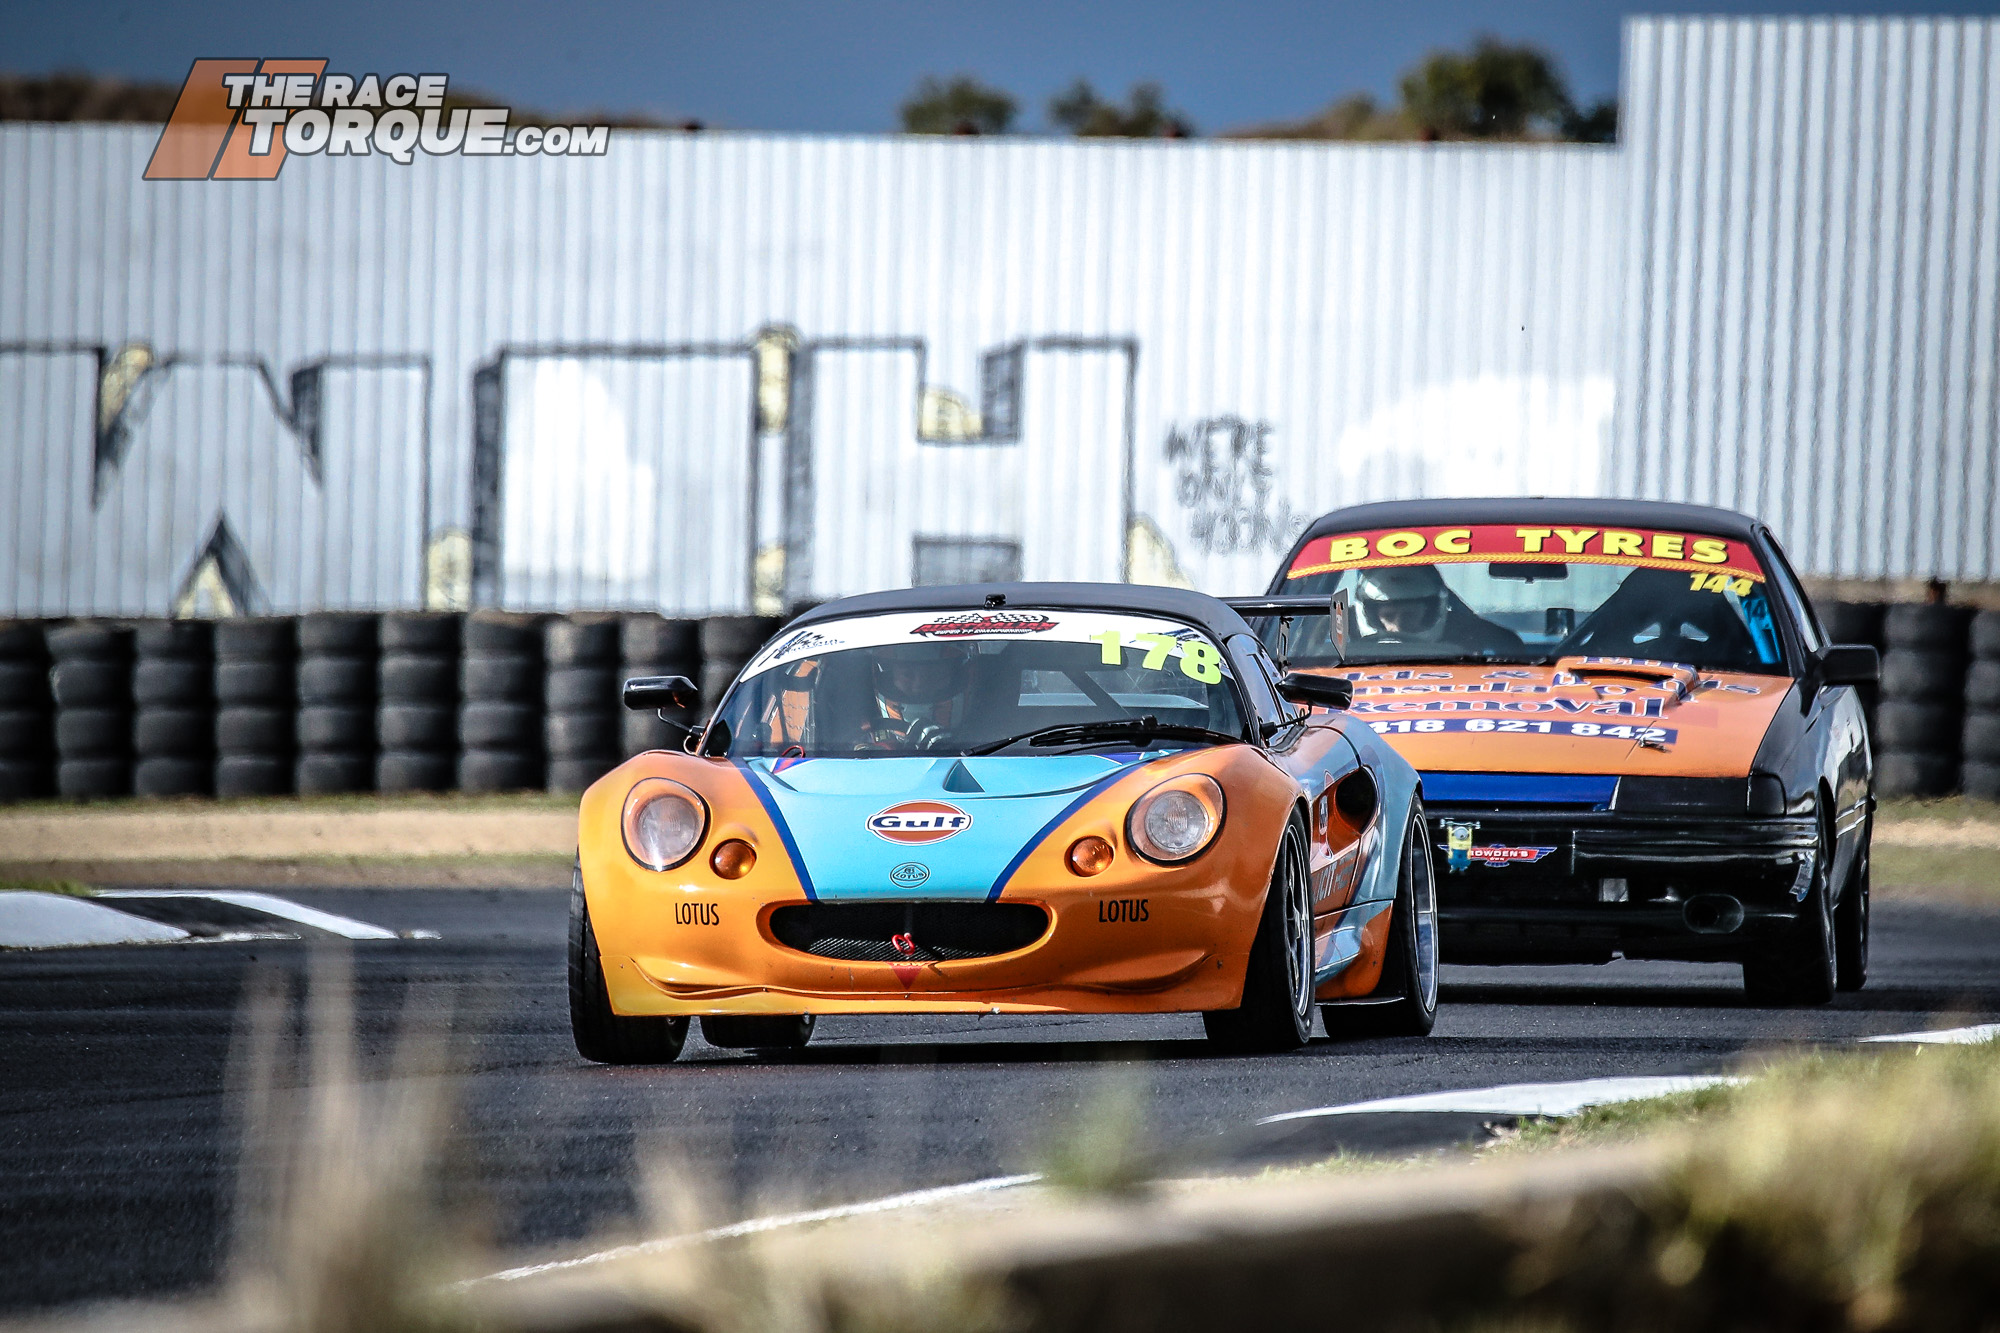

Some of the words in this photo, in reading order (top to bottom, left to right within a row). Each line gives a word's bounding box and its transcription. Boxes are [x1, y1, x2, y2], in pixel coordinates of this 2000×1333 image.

[1329, 528, 1471, 563] BOC
[1514, 527, 1730, 565] TYRES
[1689, 572, 1754, 598] 144
[1090, 630, 1222, 685] 178
[1464, 718, 1551, 733] 621
[1570, 722, 1667, 742] 842
[872, 815, 966, 829] Gulf
[896, 872, 924, 880] LOTUS
[675, 902, 720, 926] LOTUS
[1098, 898, 1150, 923] LOTUS
